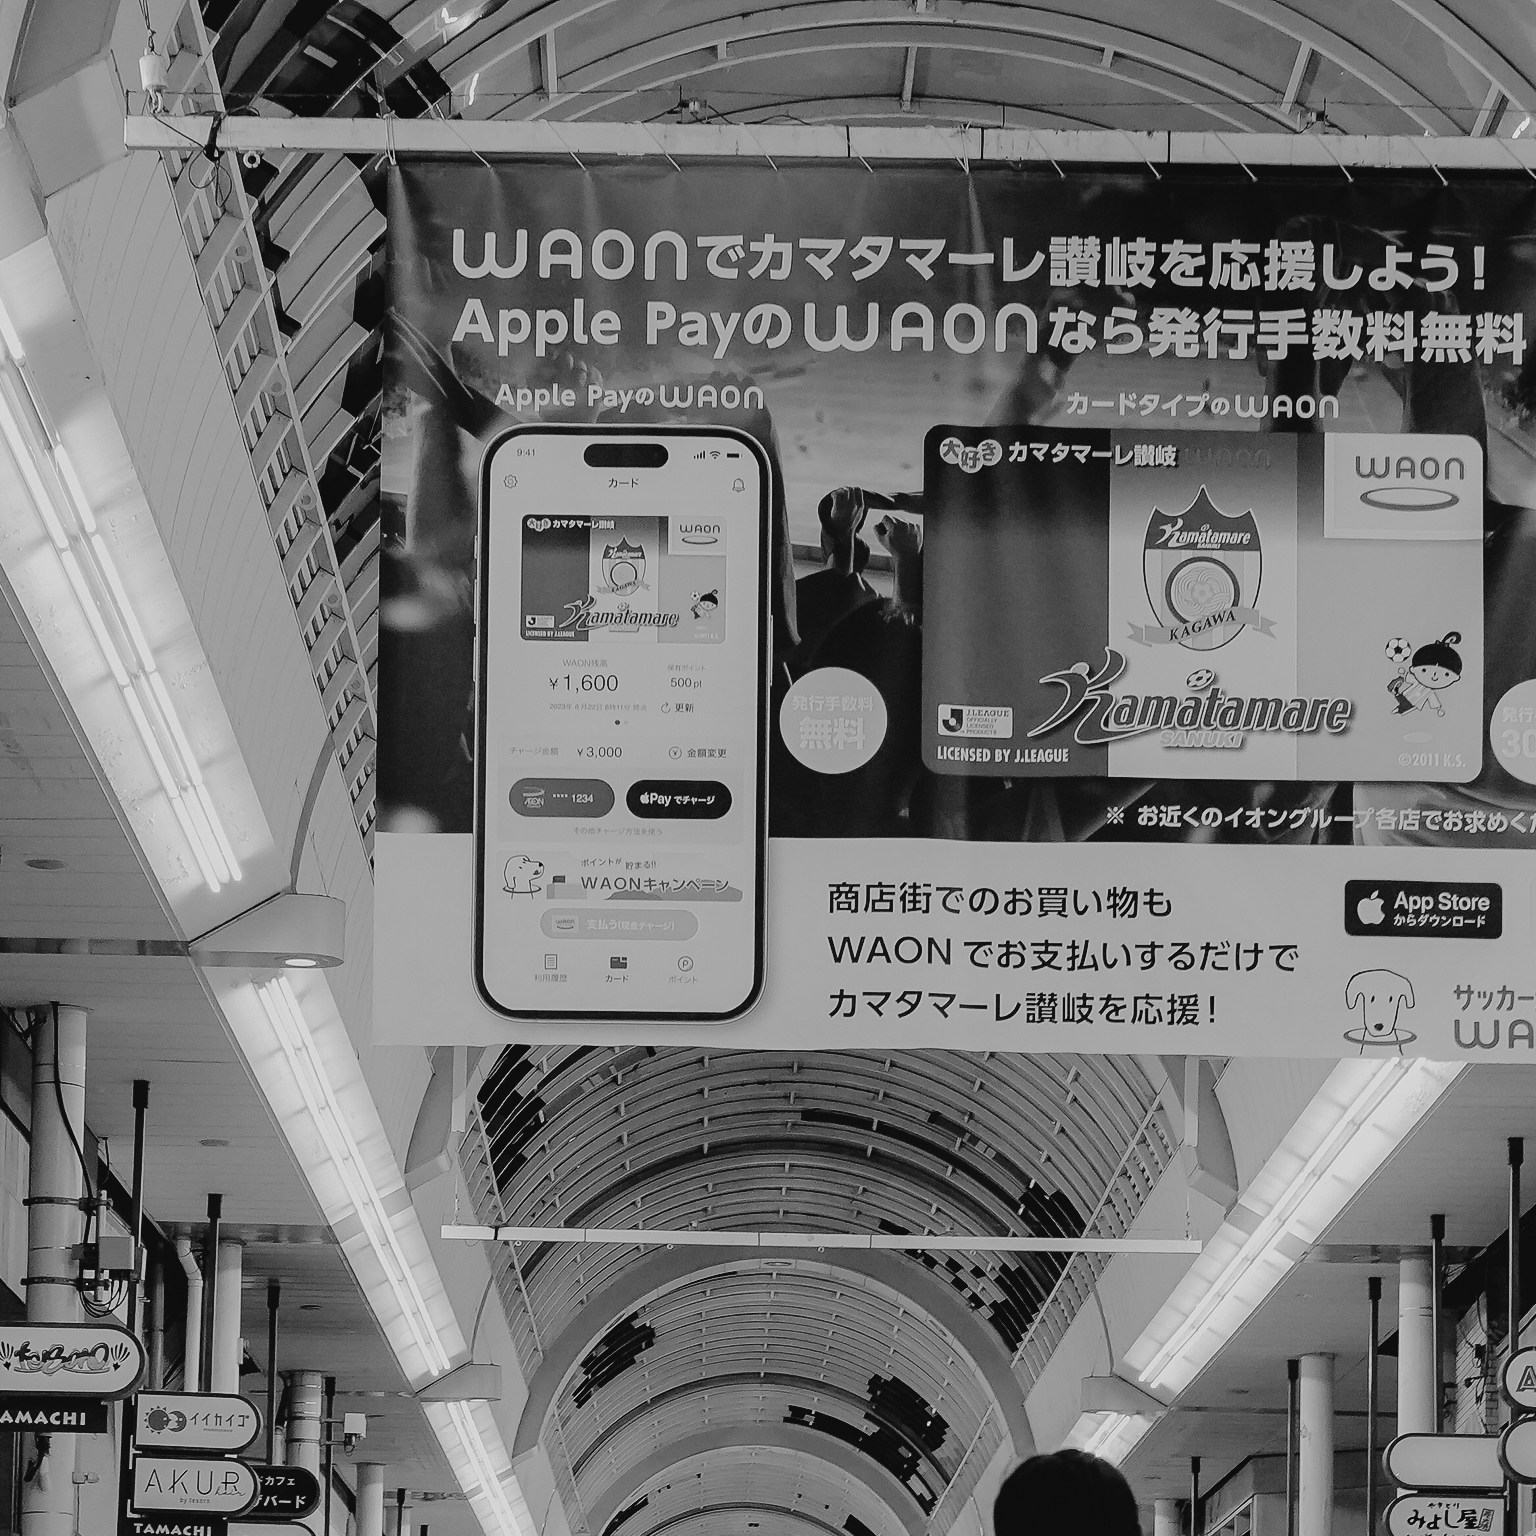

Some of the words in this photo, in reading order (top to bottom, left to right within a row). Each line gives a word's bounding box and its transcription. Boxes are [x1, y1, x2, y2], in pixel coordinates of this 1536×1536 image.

[454, 296, 619, 348] Apple
[495, 381, 575, 411] Apple
[586, 383, 765, 413] PayのWAON
[1065, 393, 1340, 422] カードタイプのWAON
[516, 448, 537, 457] 9:41
[1007, 440, 1177, 469] カマタマーレ讃岐
[1355, 455, 1465, 482] WAON
[608, 477, 639, 488] カード
[679, 523, 722, 535] WAON
[1168, 610, 1237, 641] KAGAWA
[563, 658, 608, 668] WAON残高
[791, 695, 874, 712] 発行手数料
[1027, 647, 1354, 746] Kamatamare
[674, 703, 695, 713] 更新
[966, 709, 1010, 718] J.LEAGUE
[799, 718, 868, 751] 無料
[1161, 730, 1245, 750] SANUKI
[686, 747, 727, 759] 金額変更
[937, 746, 992, 763] LICENSED
[994, 747, 1011, 763] BY
[1013, 748, 1070, 764] J.LEAGUE
[571, 793, 594, 803] 1234
[580, 875, 730, 893] WAONキャンペーン
[827, 880, 1174, 919] 商店街でのお買い物も
[1393, 891, 1435, 915] App
[1438, 892, 1491, 913] Store
[1393, 912, 1487, 930] からダウンロード
[533, 973, 568, 983] 利用履歴
[604, 973, 629, 983] カード
[668, 974, 698, 984] ポイント
[189, 1412, 249, 1428] イイカイゴ
[1406, 1508, 1479, 1531] みよし屋
[133, 1523, 212, 1536] TAMACHI
